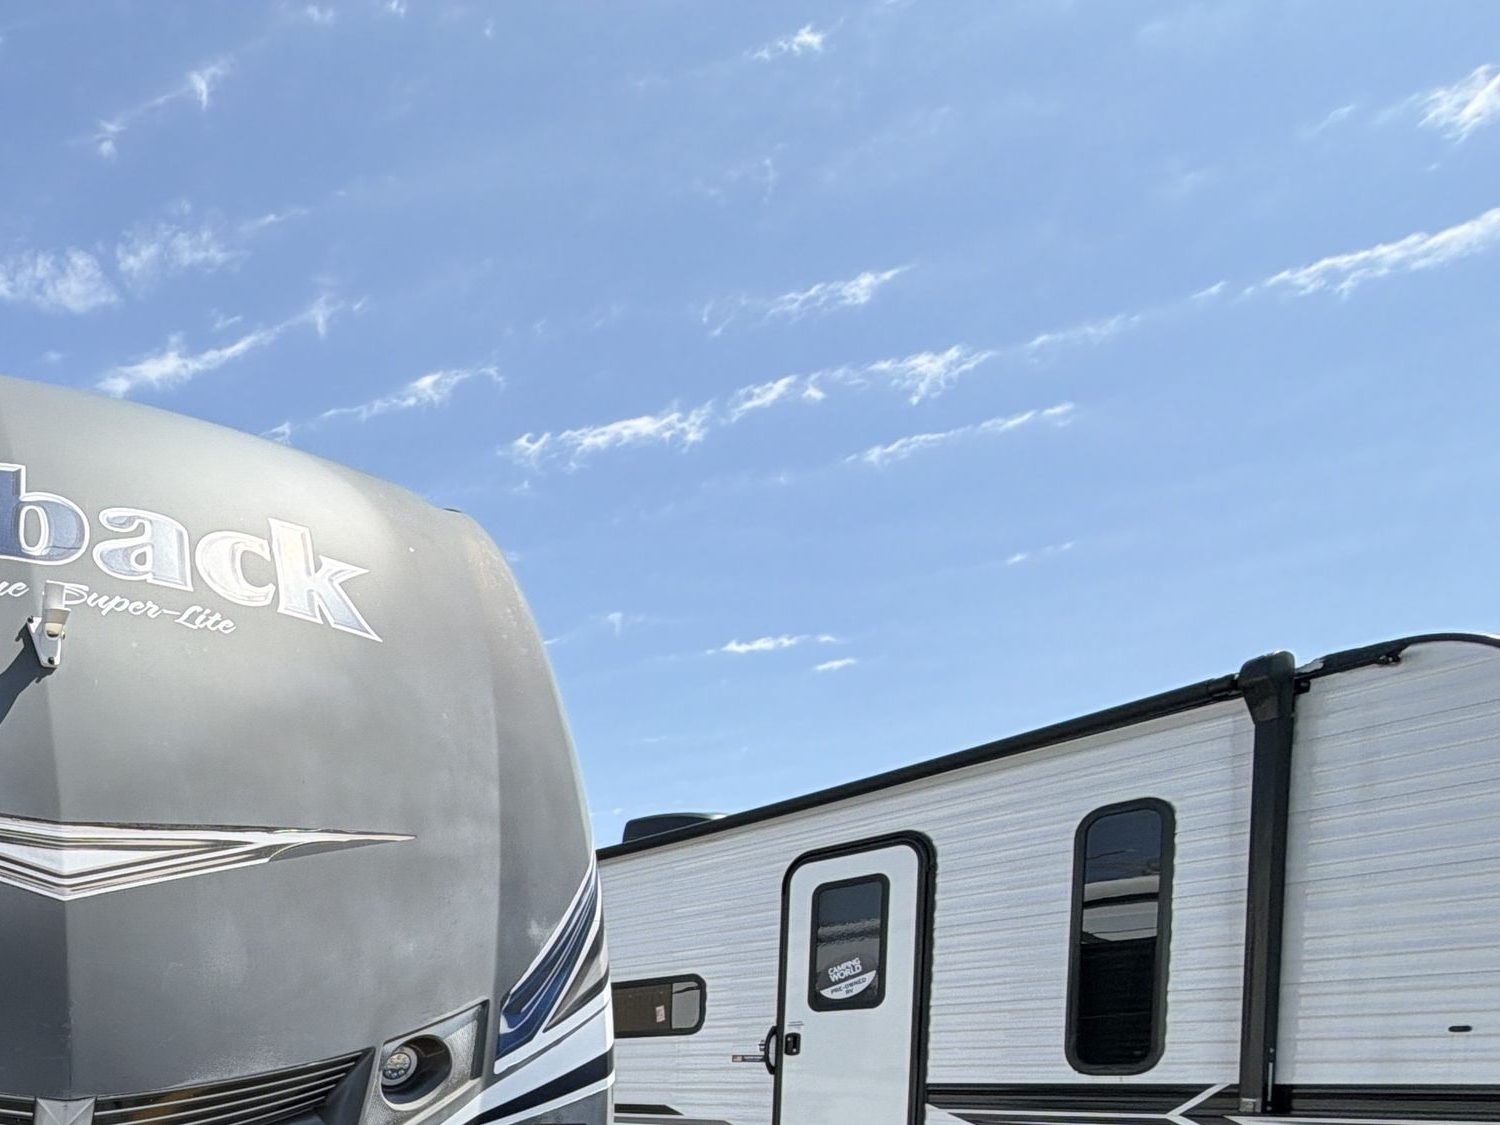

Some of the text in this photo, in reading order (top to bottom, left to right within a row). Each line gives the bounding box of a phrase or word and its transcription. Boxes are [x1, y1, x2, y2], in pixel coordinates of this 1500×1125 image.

[828, 957, 861, 975] CAMPING
[829, 964, 862, 982] WORLD
[830, 977, 867, 994] PRE-OWNED
